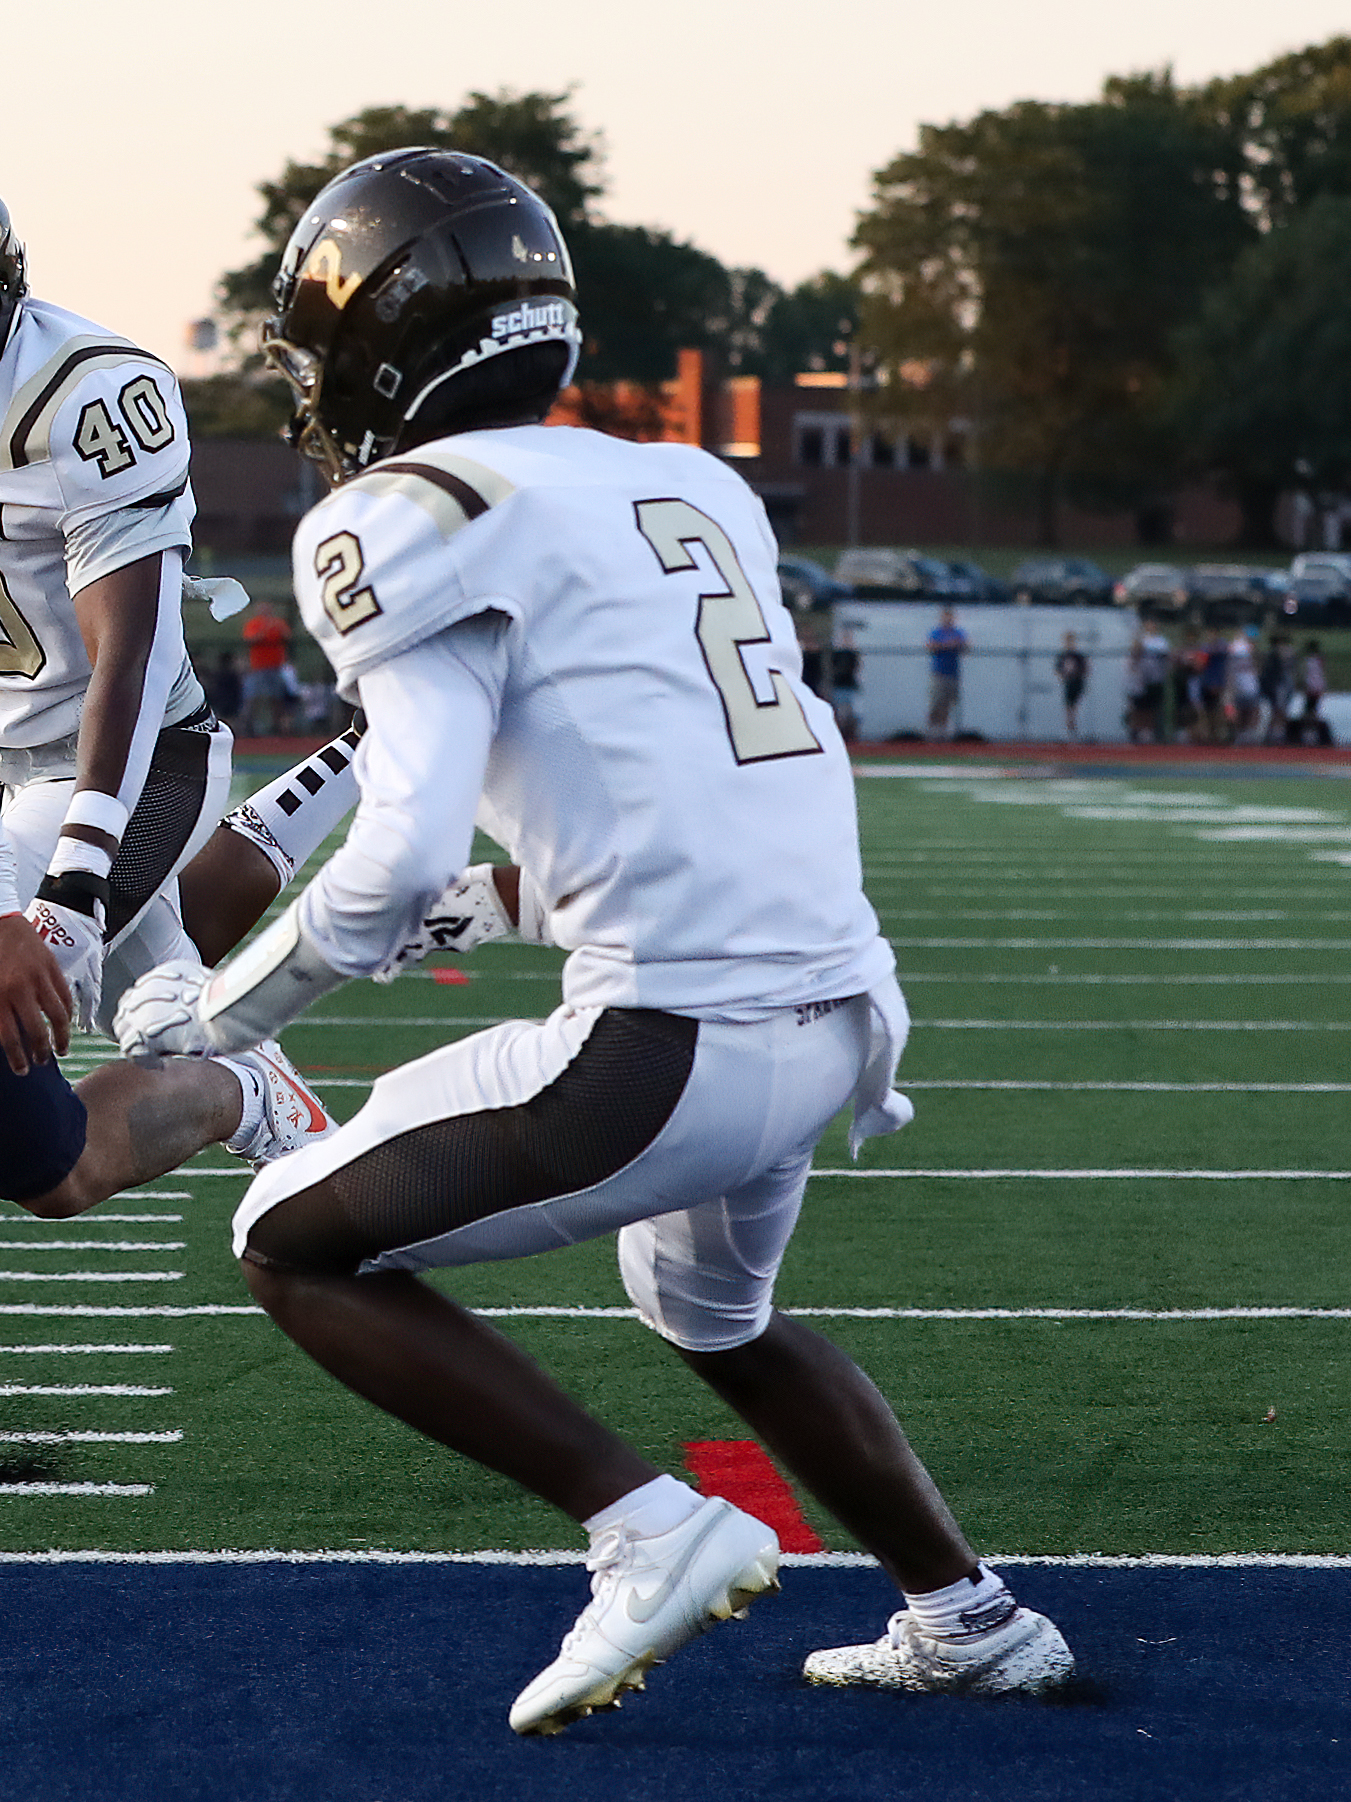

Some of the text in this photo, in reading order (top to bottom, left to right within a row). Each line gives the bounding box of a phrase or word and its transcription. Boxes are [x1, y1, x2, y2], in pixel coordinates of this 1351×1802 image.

[308, 239, 363, 310] 2
[491, 302, 565, 338] schutt
[72, 374, 175, 480] 40
[314, 529, 385, 638] 2
[633, 497, 826, 767] 2
[36, 902, 75, 948] adidas
